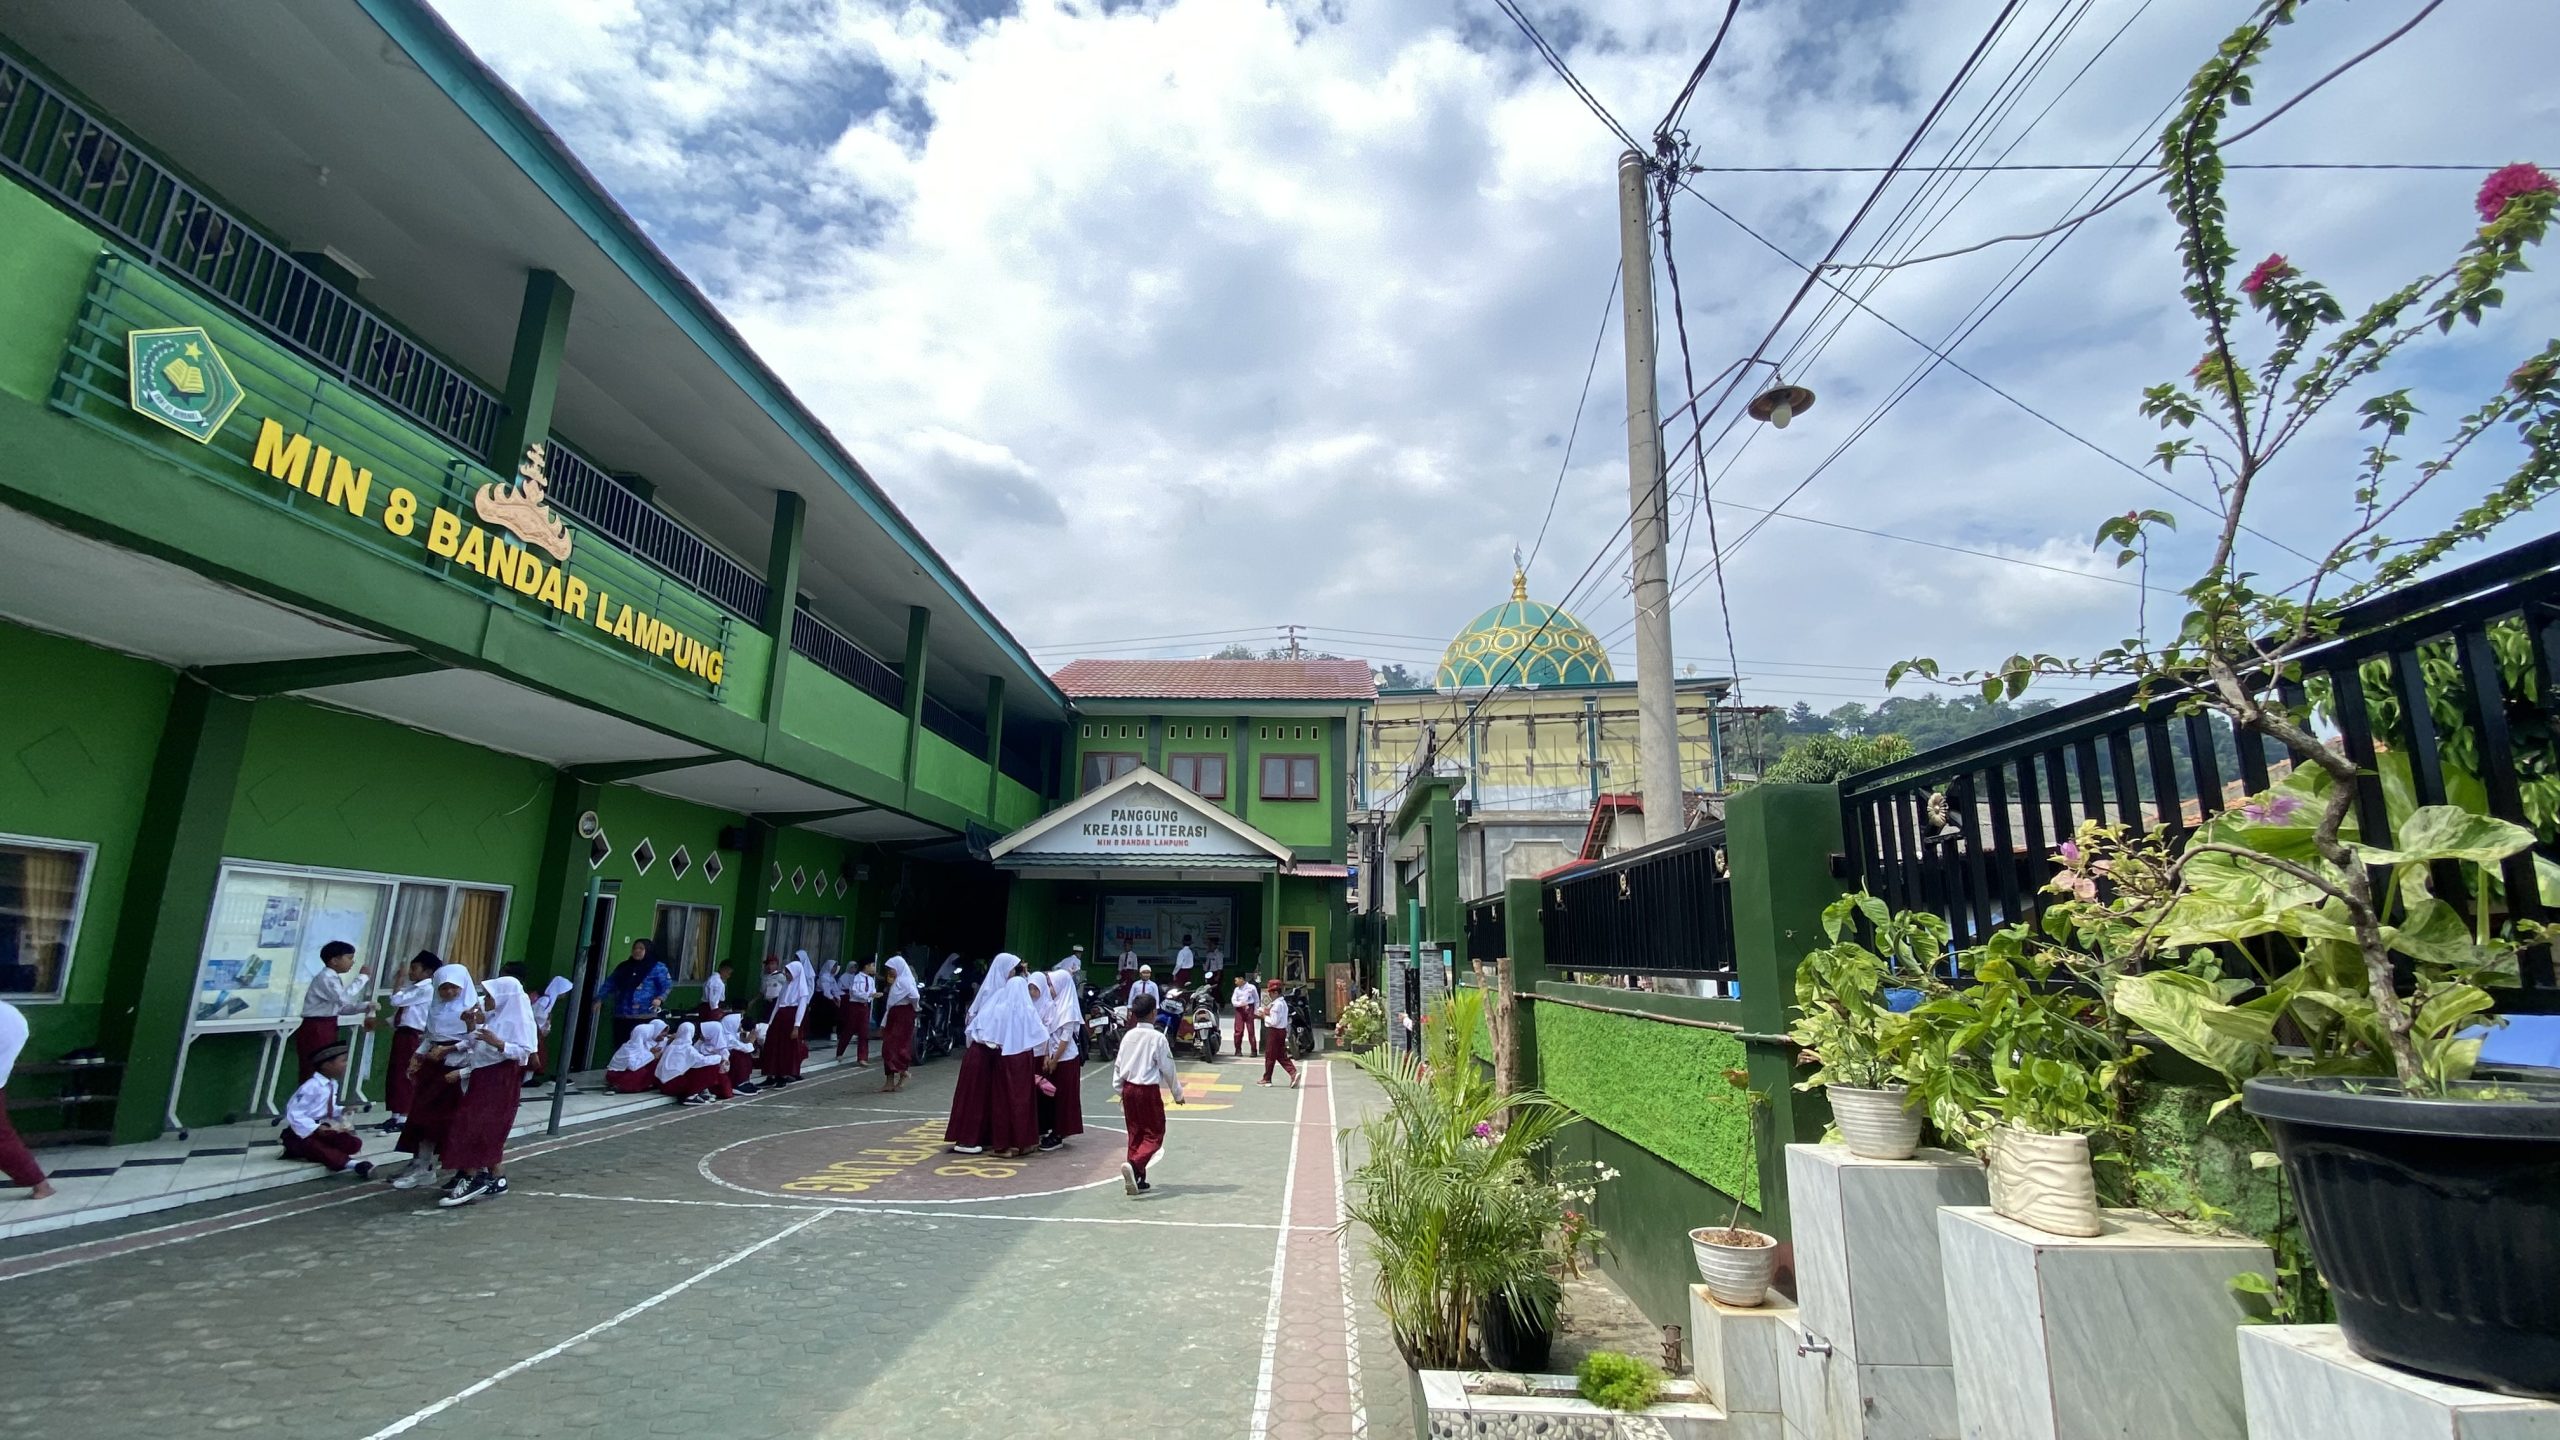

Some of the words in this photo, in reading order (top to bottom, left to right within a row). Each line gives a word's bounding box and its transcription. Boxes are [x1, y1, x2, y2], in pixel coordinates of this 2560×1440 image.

[252, 417, 373, 518] MIN
[384, 487, 418, 537] 8
[427, 507, 589, 620] BANDAR
[595, 591, 724, 685] LAMPUNG
[1111, 809, 1178, 822] PANGGUNG
[1083, 823, 1132, 837] KREASI
[1147, 824, 1208, 838] LITERASI
[1121, 839, 1151, 847] BANDAR
[1154, 839, 1189, 847] LAMPUNG
